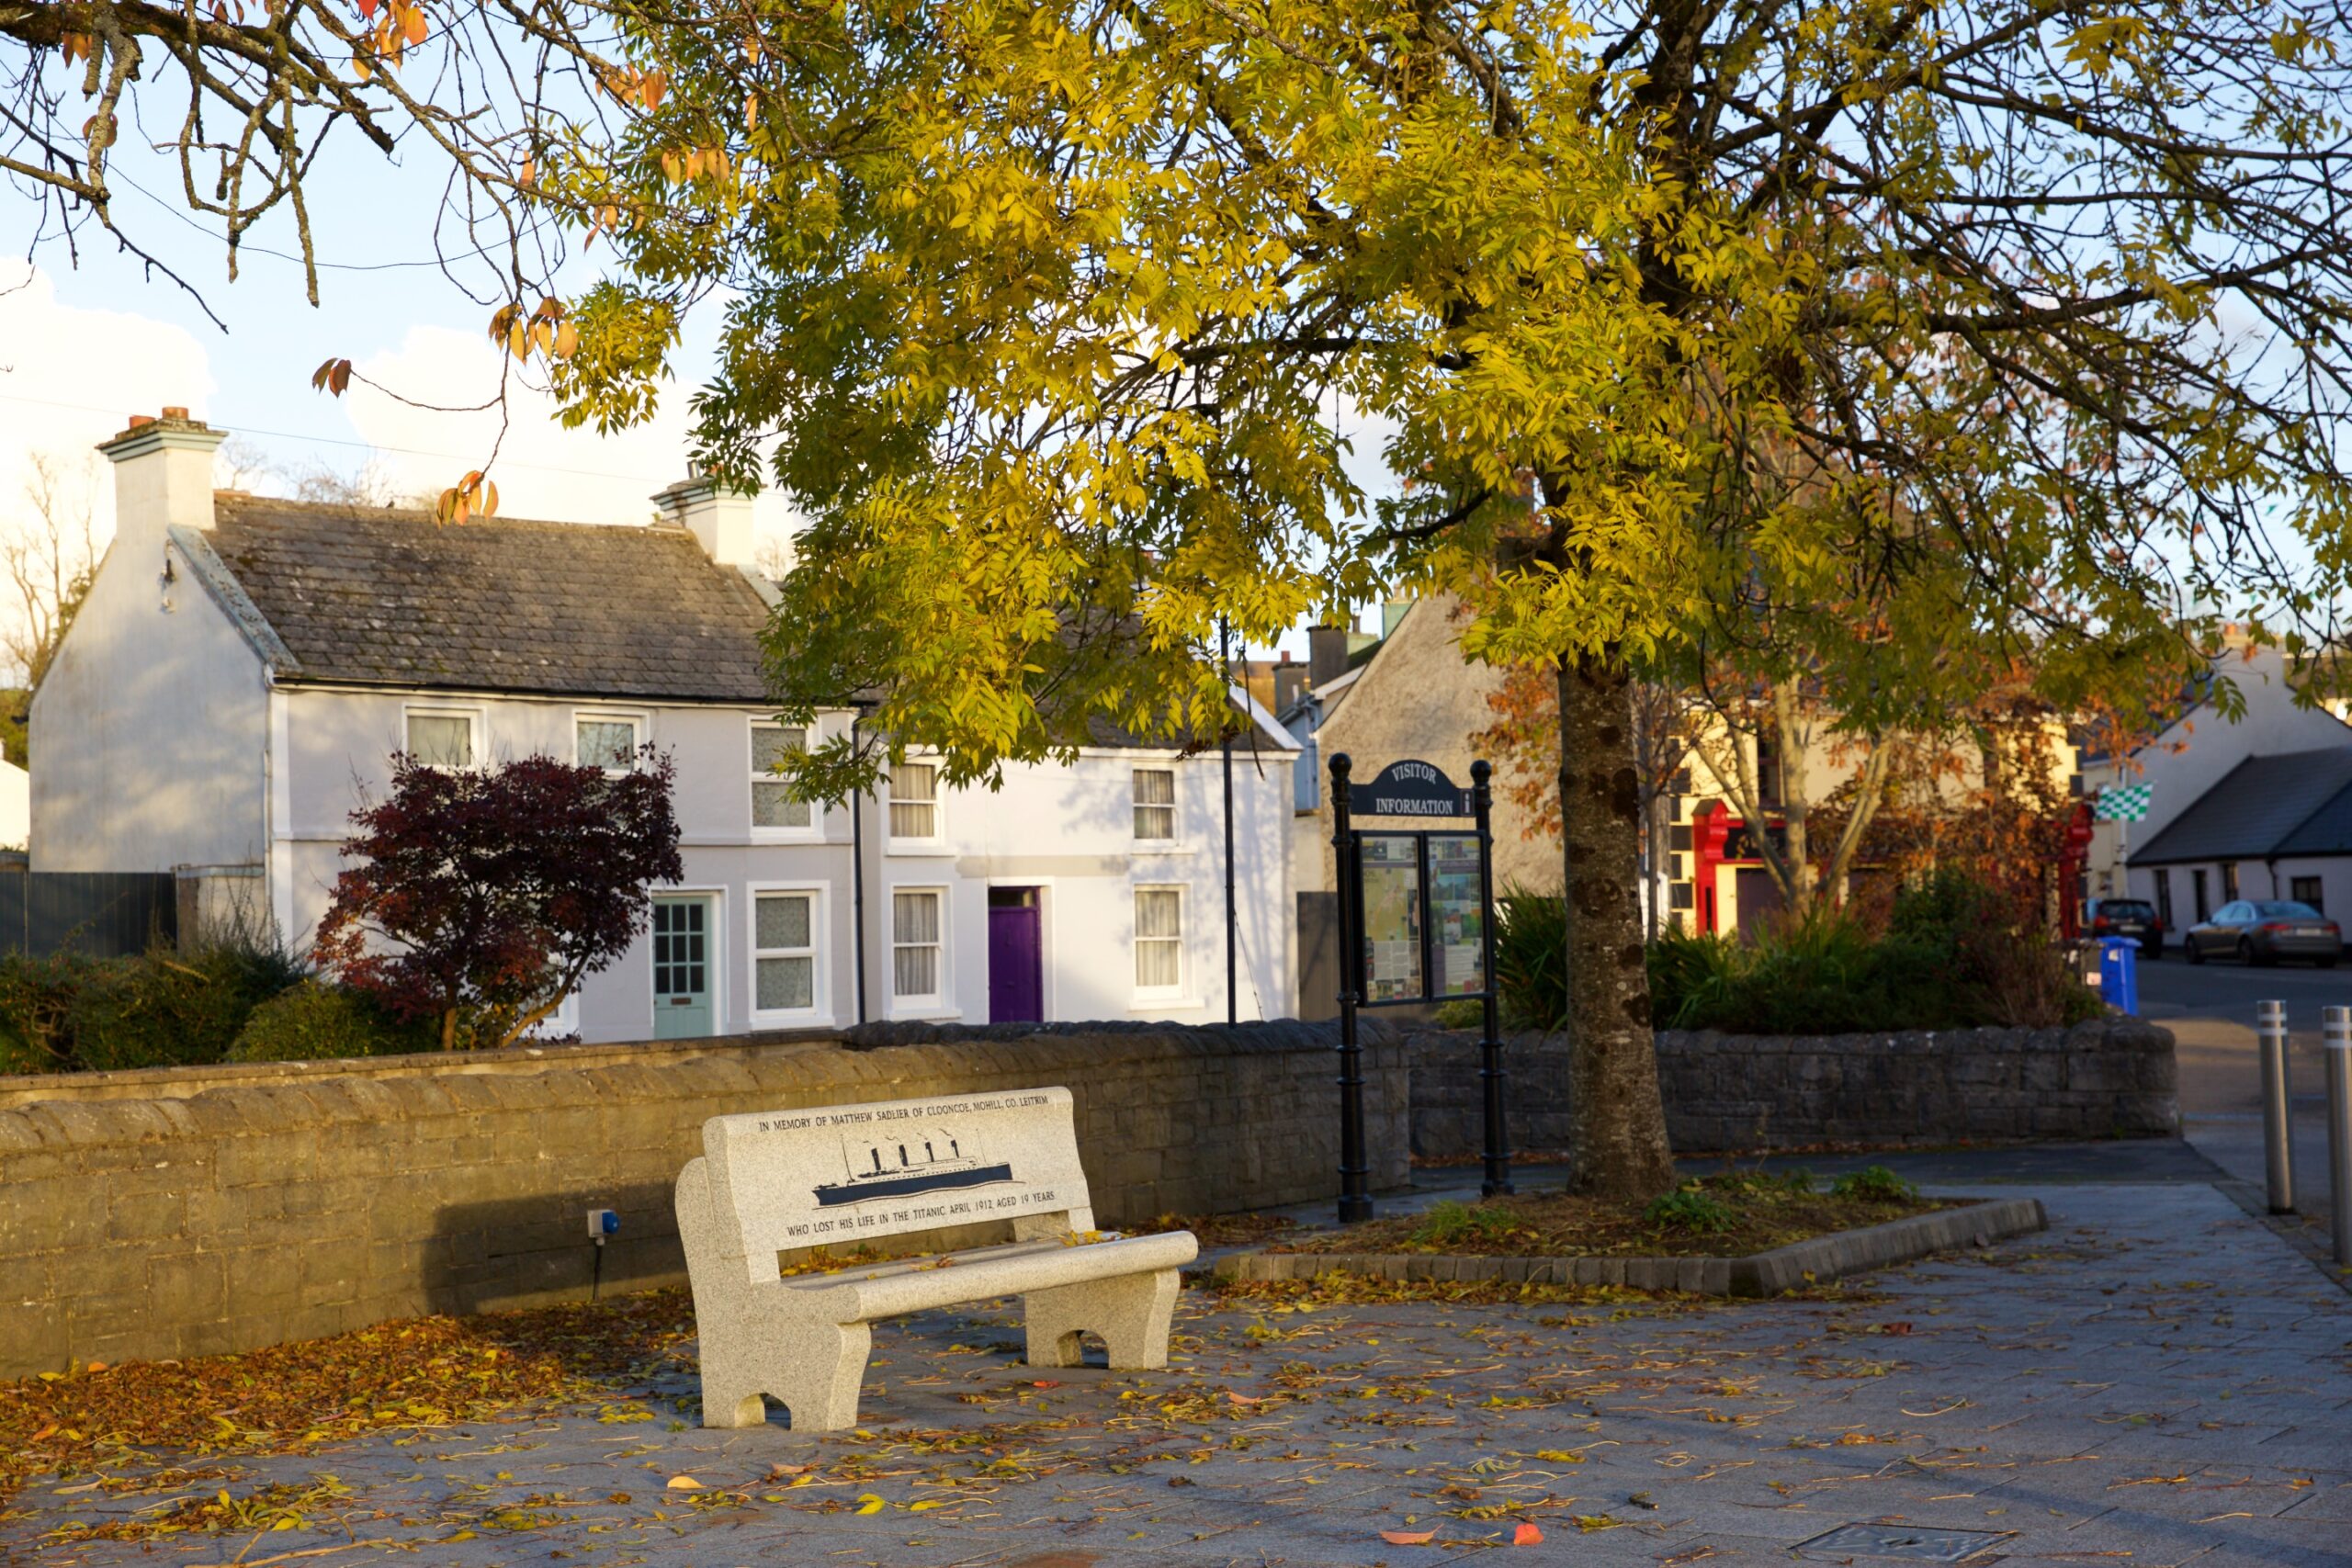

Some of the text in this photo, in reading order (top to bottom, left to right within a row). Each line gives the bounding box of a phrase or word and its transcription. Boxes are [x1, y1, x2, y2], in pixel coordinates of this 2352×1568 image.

[1392, 762, 1437, 784] VISITOR
[1375, 797, 1453, 815] INFORMATION
[759, 1122, 770, 1133] IN
[774, 1118, 810, 1131] MEMORY
[816, 1116, 826, 1127] OF
[831, 1112, 873, 1124] MATTHEW
[876, 1109, 910, 1121] SADLIER
[912, 1107, 923, 1118] OF
[927, 1103, 972, 1116] CLOONCOE,
[1019, 1095, 1049, 1107] LEITRIM
[787, 1190, 1055, 1236] WHO LOST HIS LIFE IN THE TITANIC APRIL 1912 AGED 19 YEARS
